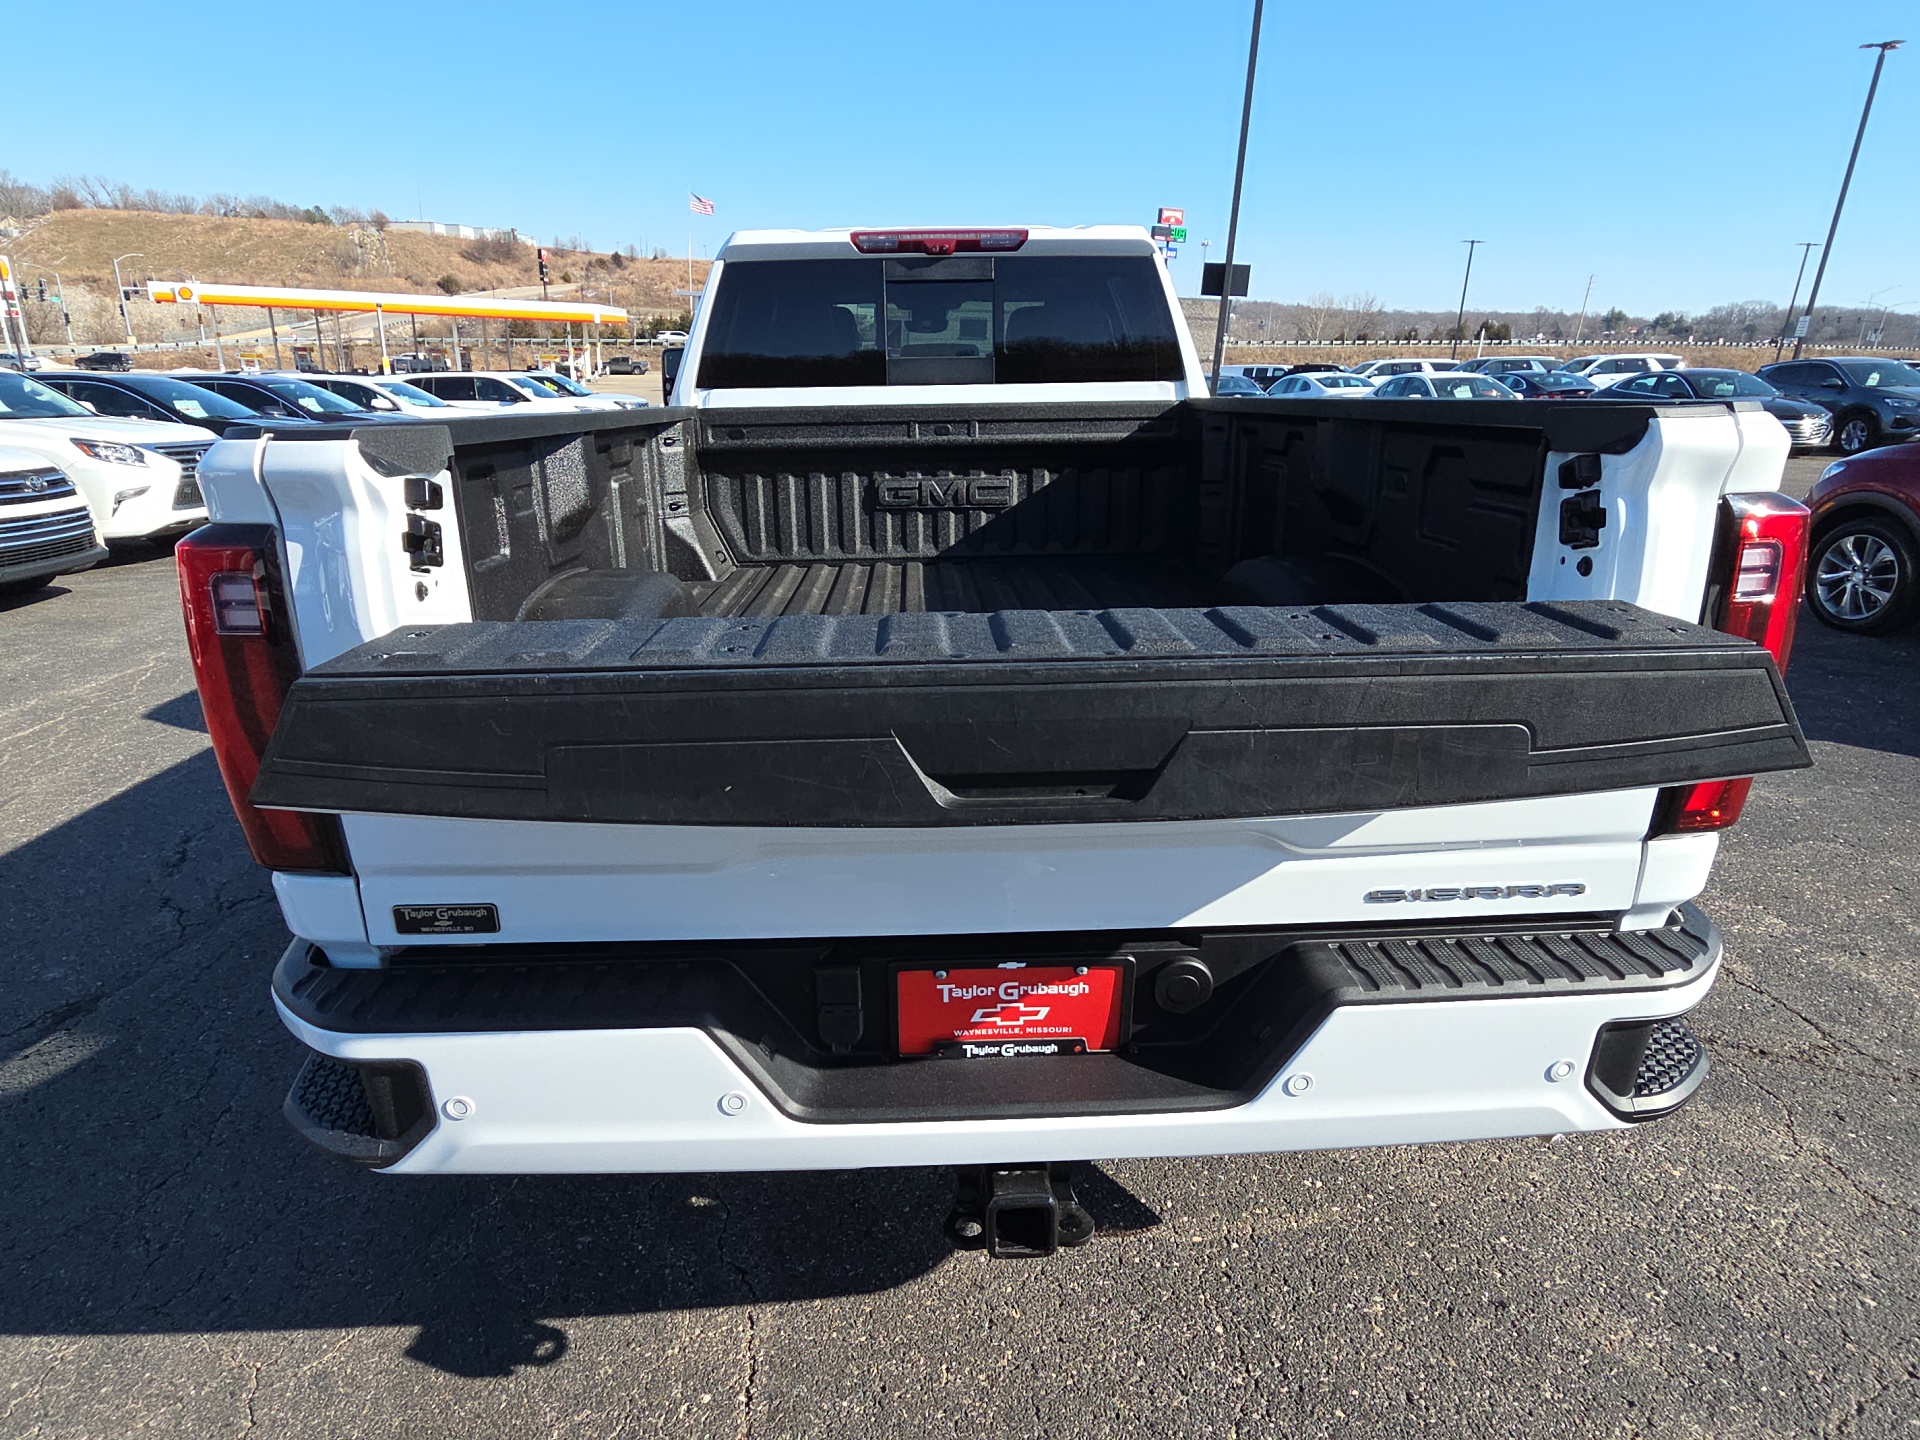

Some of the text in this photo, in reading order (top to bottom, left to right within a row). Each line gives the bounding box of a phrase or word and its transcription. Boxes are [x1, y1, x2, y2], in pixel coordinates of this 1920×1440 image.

[879, 479, 1010, 506] GMC
[1363, 883, 1587, 904] SIERRA
[400, 907, 488, 921] Taylor Grubaugh
[936, 981, 1090, 1003] Taylor Grubaugh
[953, 1026, 1073, 1037] WAYNESVILLE, MISSOURI
[962, 1043, 1059, 1058] Taylor Grubaugh
